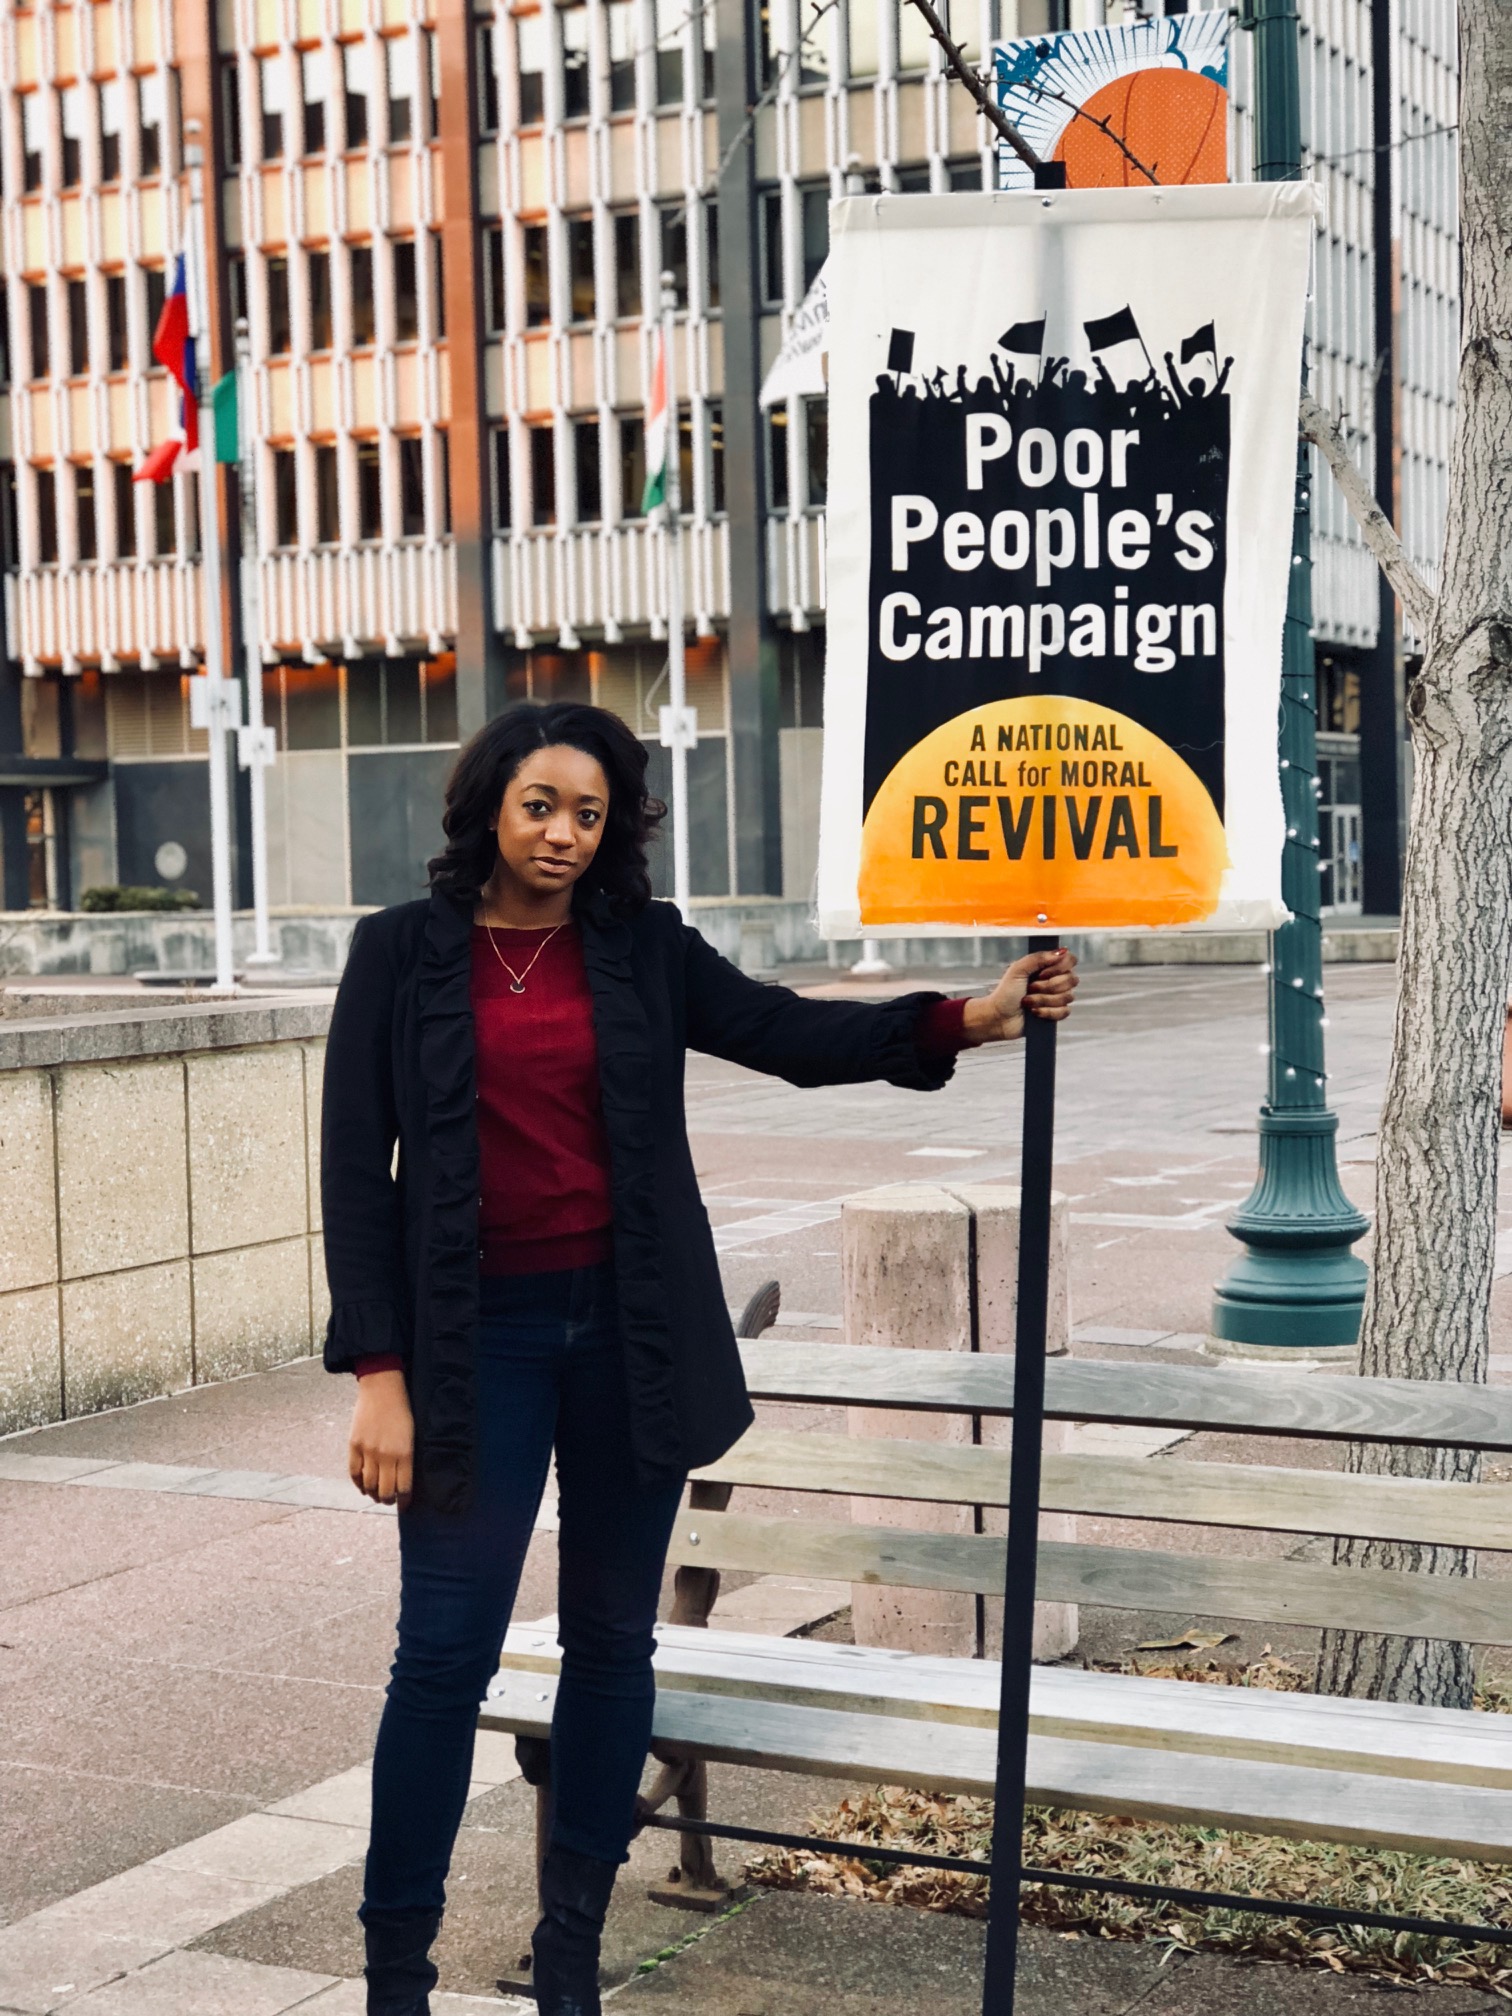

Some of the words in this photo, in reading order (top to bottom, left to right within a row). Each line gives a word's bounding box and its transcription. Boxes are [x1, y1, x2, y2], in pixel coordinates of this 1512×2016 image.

[966, 413, 1140, 490] Poor
[892, 493, 1214, 587] People's
[880, 586, 1216, 673] Campaign
[970, 724, 987, 752] A
[997, 723, 1123, 752] NATIONAL
[944, 760, 1008, 787] CALL
[1017, 760, 1052, 787] for
[1061, 760, 1152, 788] MORAL
[912, 795, 1178, 861] REVIVAL
